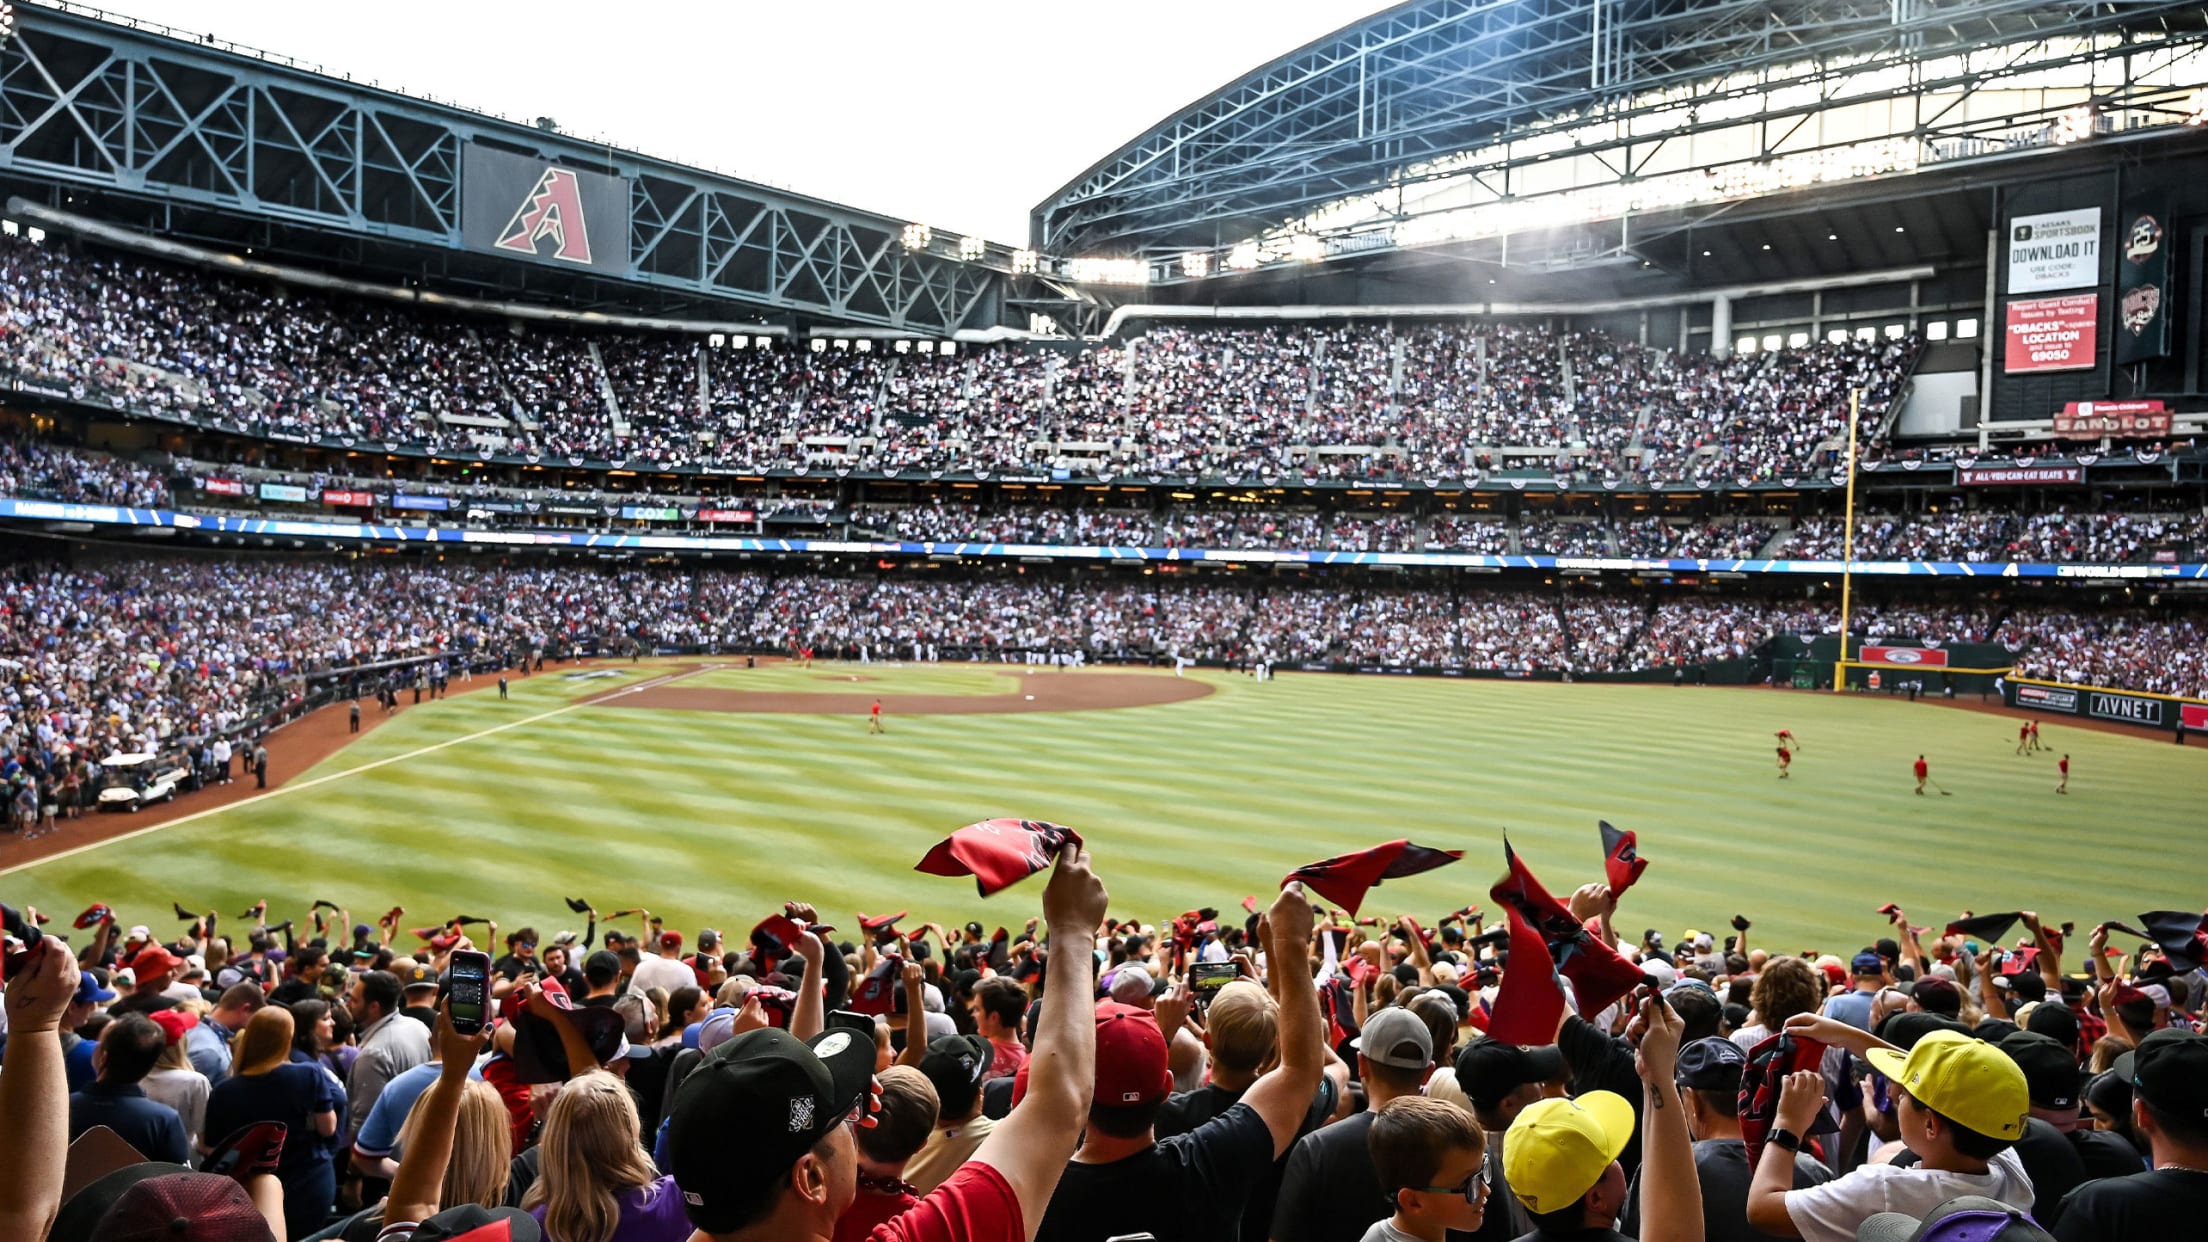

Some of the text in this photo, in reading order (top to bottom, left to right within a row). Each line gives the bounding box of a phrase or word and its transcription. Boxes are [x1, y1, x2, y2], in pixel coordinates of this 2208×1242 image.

[494, 167, 592, 264] A
[2034, 220, 2071, 229] CAESARS
[2034, 224, 2096, 240] SPORTSBOOK
[2012, 240, 2096, 264] DOWNLOAD IT
[2022, 331, 2080, 344] LOCATION
[2031, 349, 2069, 362] 69050
[2055, 416, 2167, 432] SANDLOT
[634, 507, 667, 518] COX
[2097, 697, 2154, 719] AVNET
